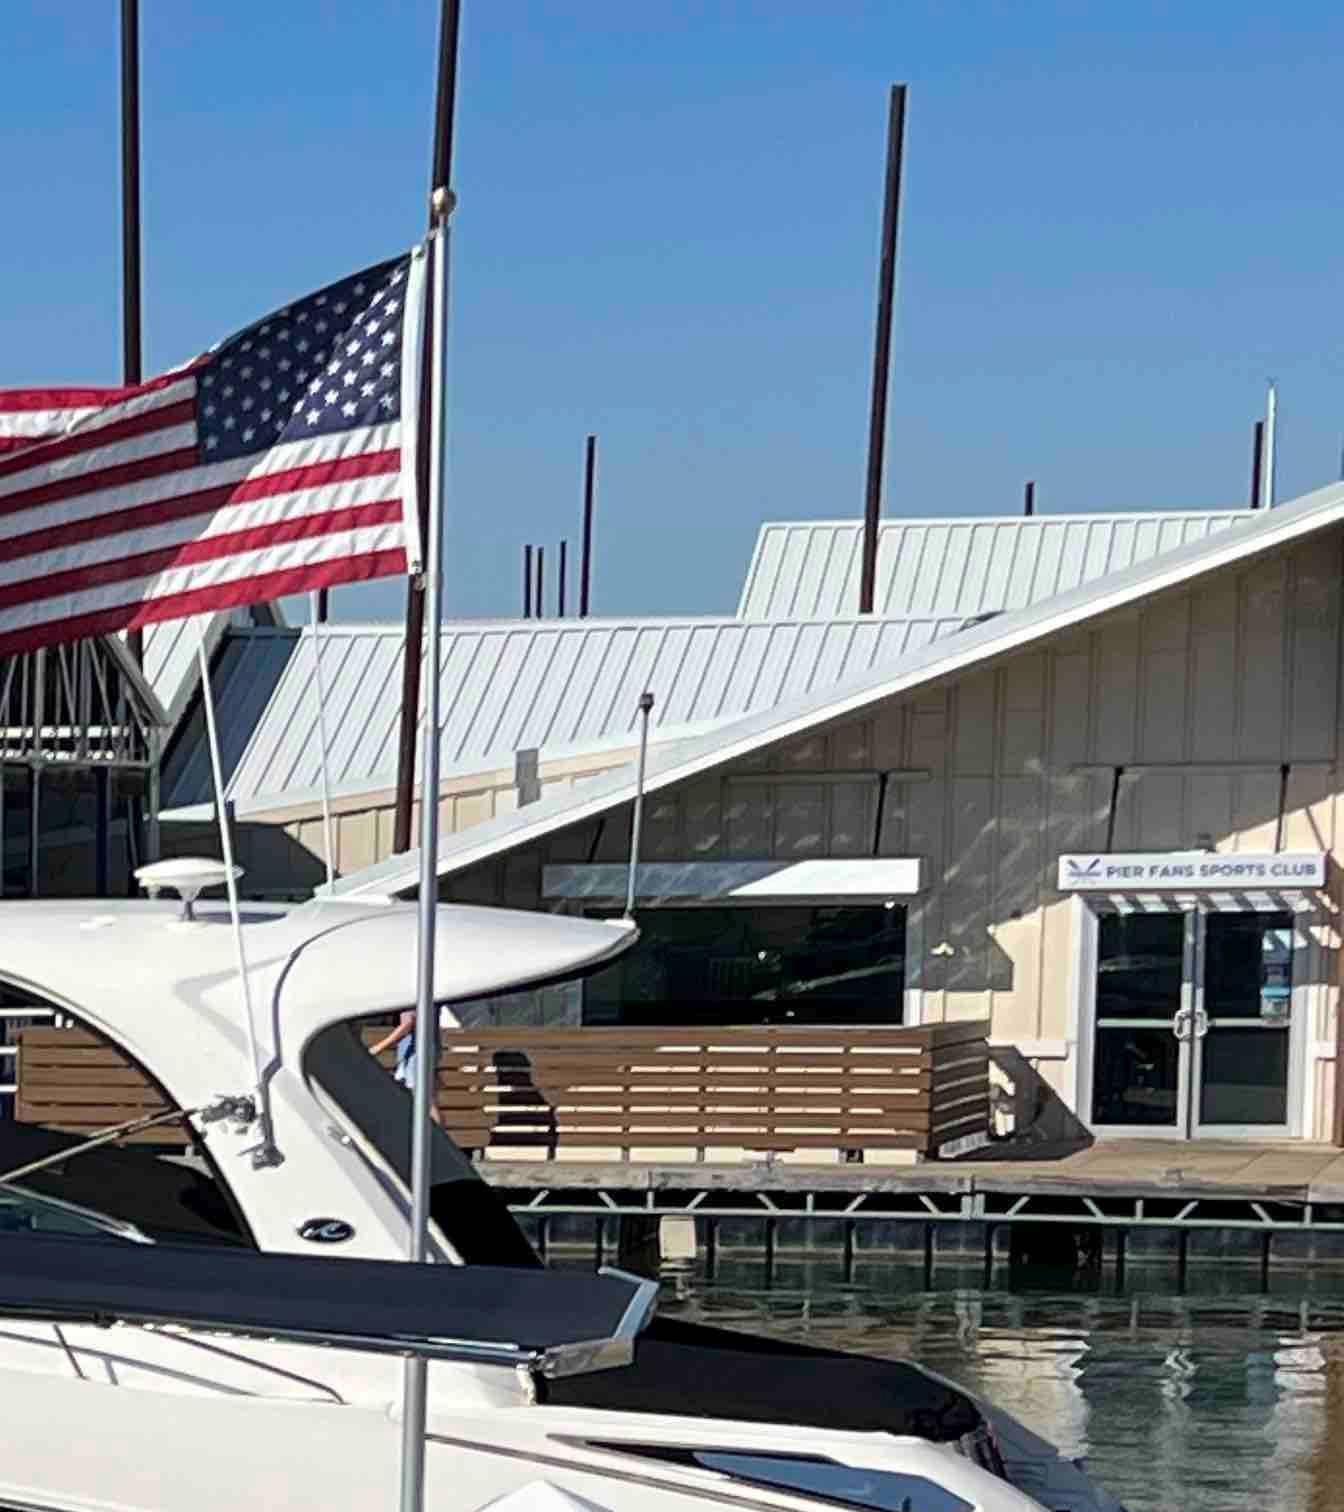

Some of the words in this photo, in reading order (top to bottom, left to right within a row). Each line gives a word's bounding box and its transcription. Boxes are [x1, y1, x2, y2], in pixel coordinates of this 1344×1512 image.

[1106, 866, 1145, 879] PIER
[1150, 865, 1195, 878] FANS
[1200, 864, 1266, 878] SPORTS
[1271, 863, 1317, 876] CLUB
